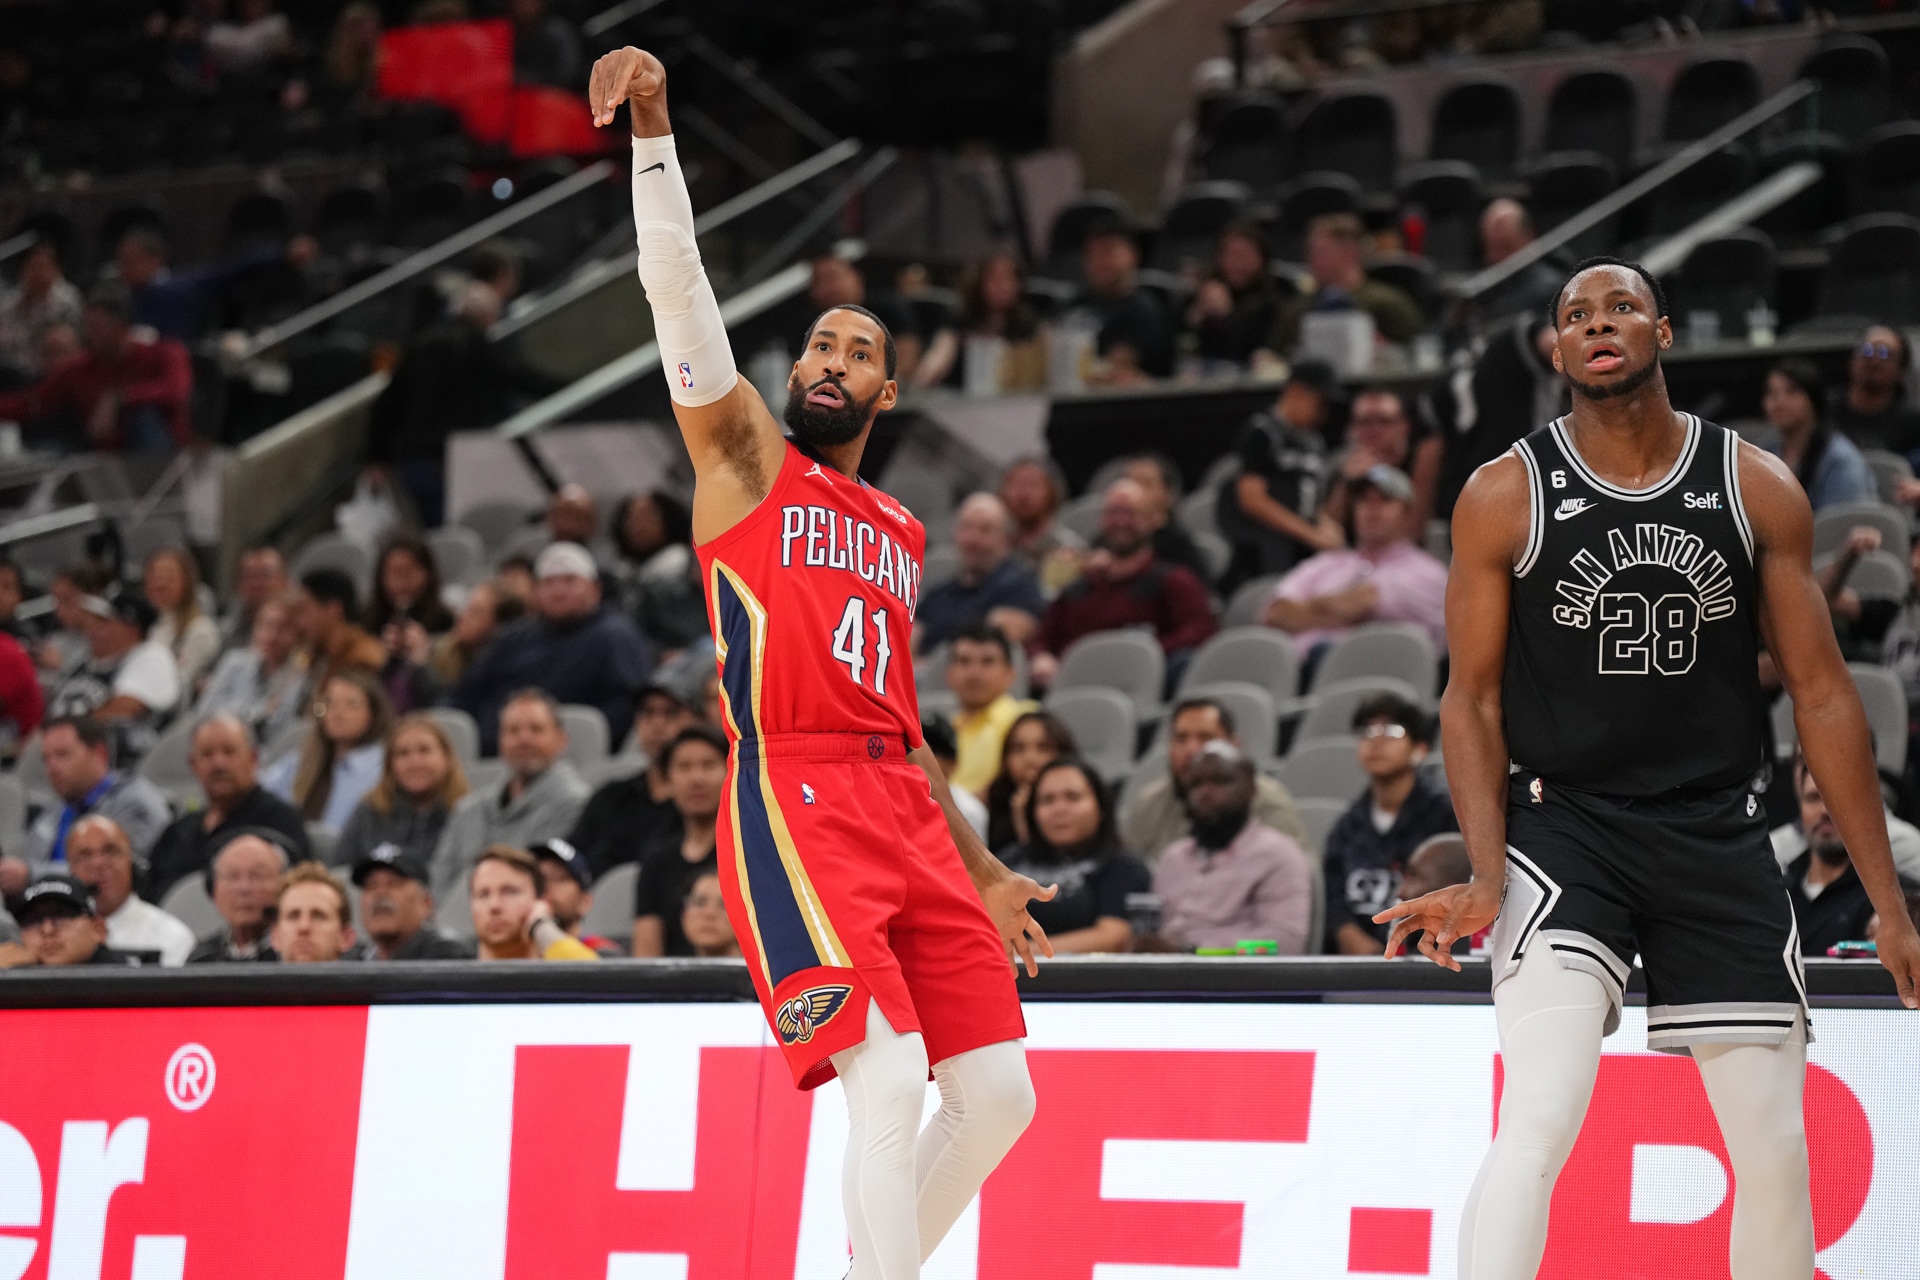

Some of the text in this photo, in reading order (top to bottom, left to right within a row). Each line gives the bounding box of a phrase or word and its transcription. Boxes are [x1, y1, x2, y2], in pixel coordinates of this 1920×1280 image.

[1551, 470, 1567, 489] 6
[1560, 498, 1587, 512] NIKE
[781, 505, 920, 624] PELICANS
[1552, 523, 1737, 630] SAN ANTONIO
[832, 597, 892, 696] 41
[1598, 592, 1701, 676] 28
